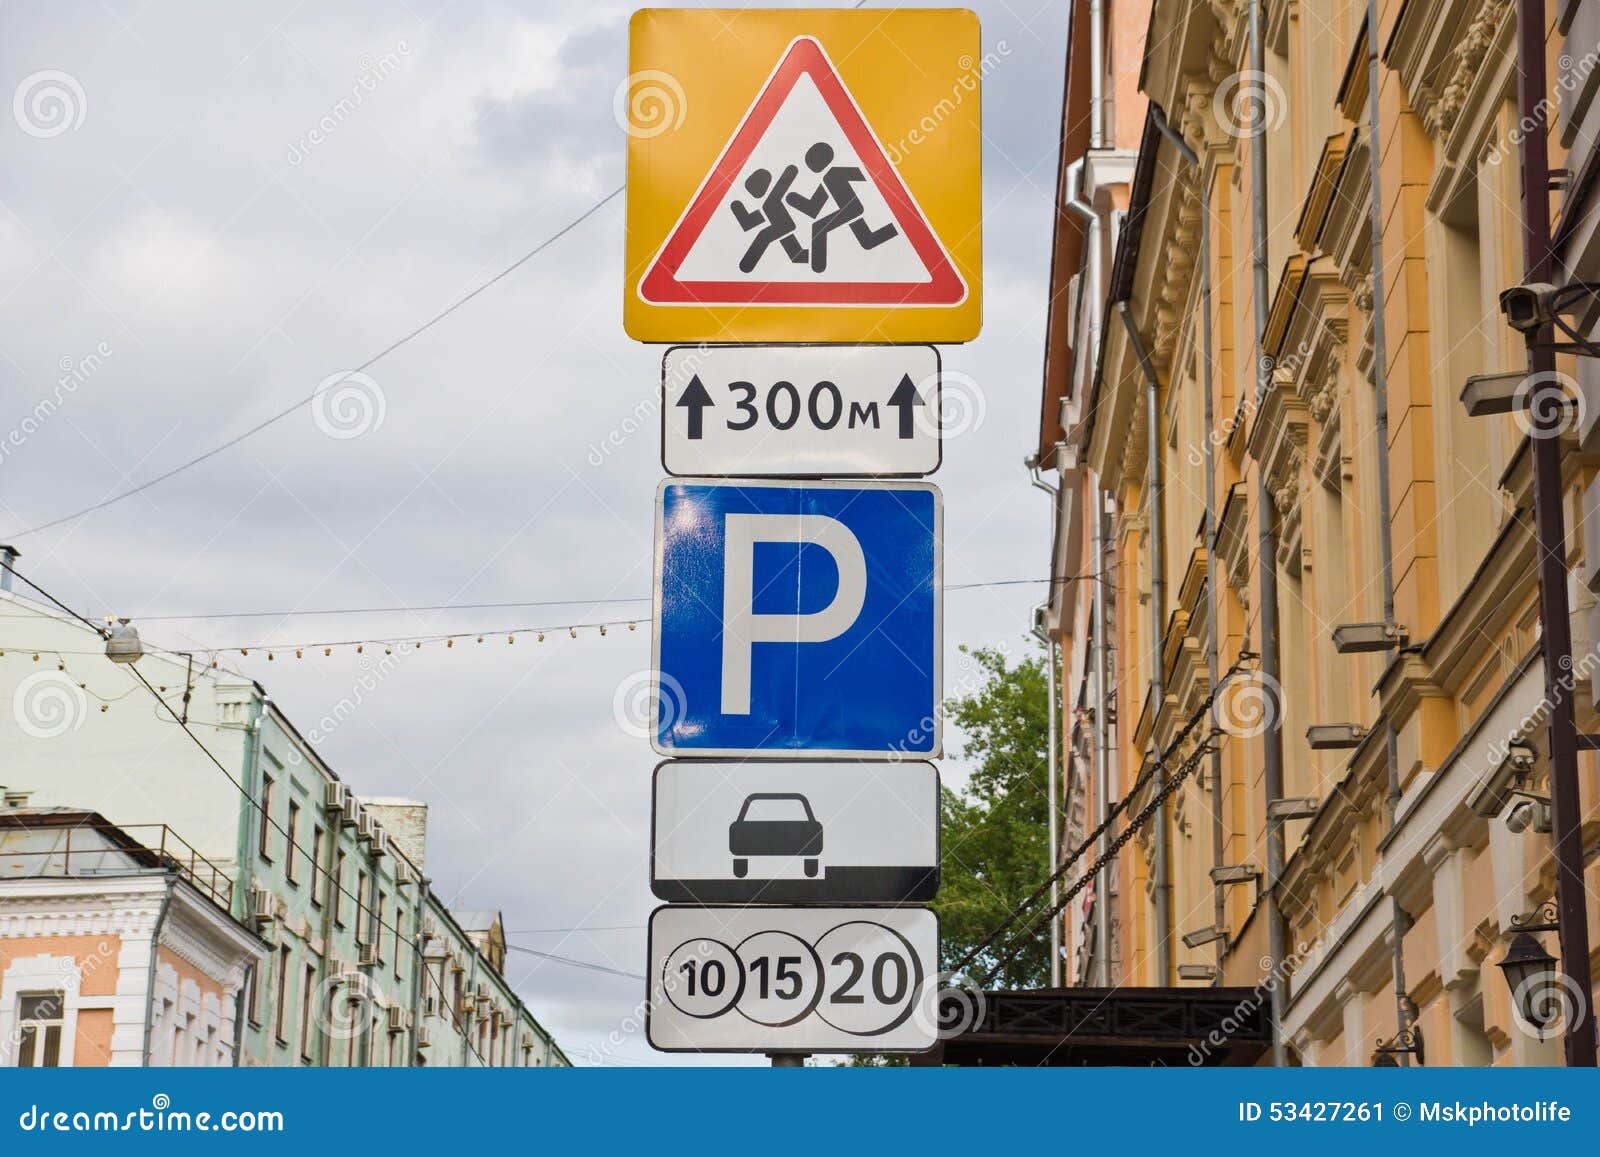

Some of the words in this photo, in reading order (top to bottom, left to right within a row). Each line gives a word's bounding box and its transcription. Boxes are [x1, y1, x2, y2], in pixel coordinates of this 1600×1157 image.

[721, 513, 867, 716] P
[679, 959, 726, 997] 10
[749, 956, 803, 1000] 15
[829, 951, 909, 1005] 20
